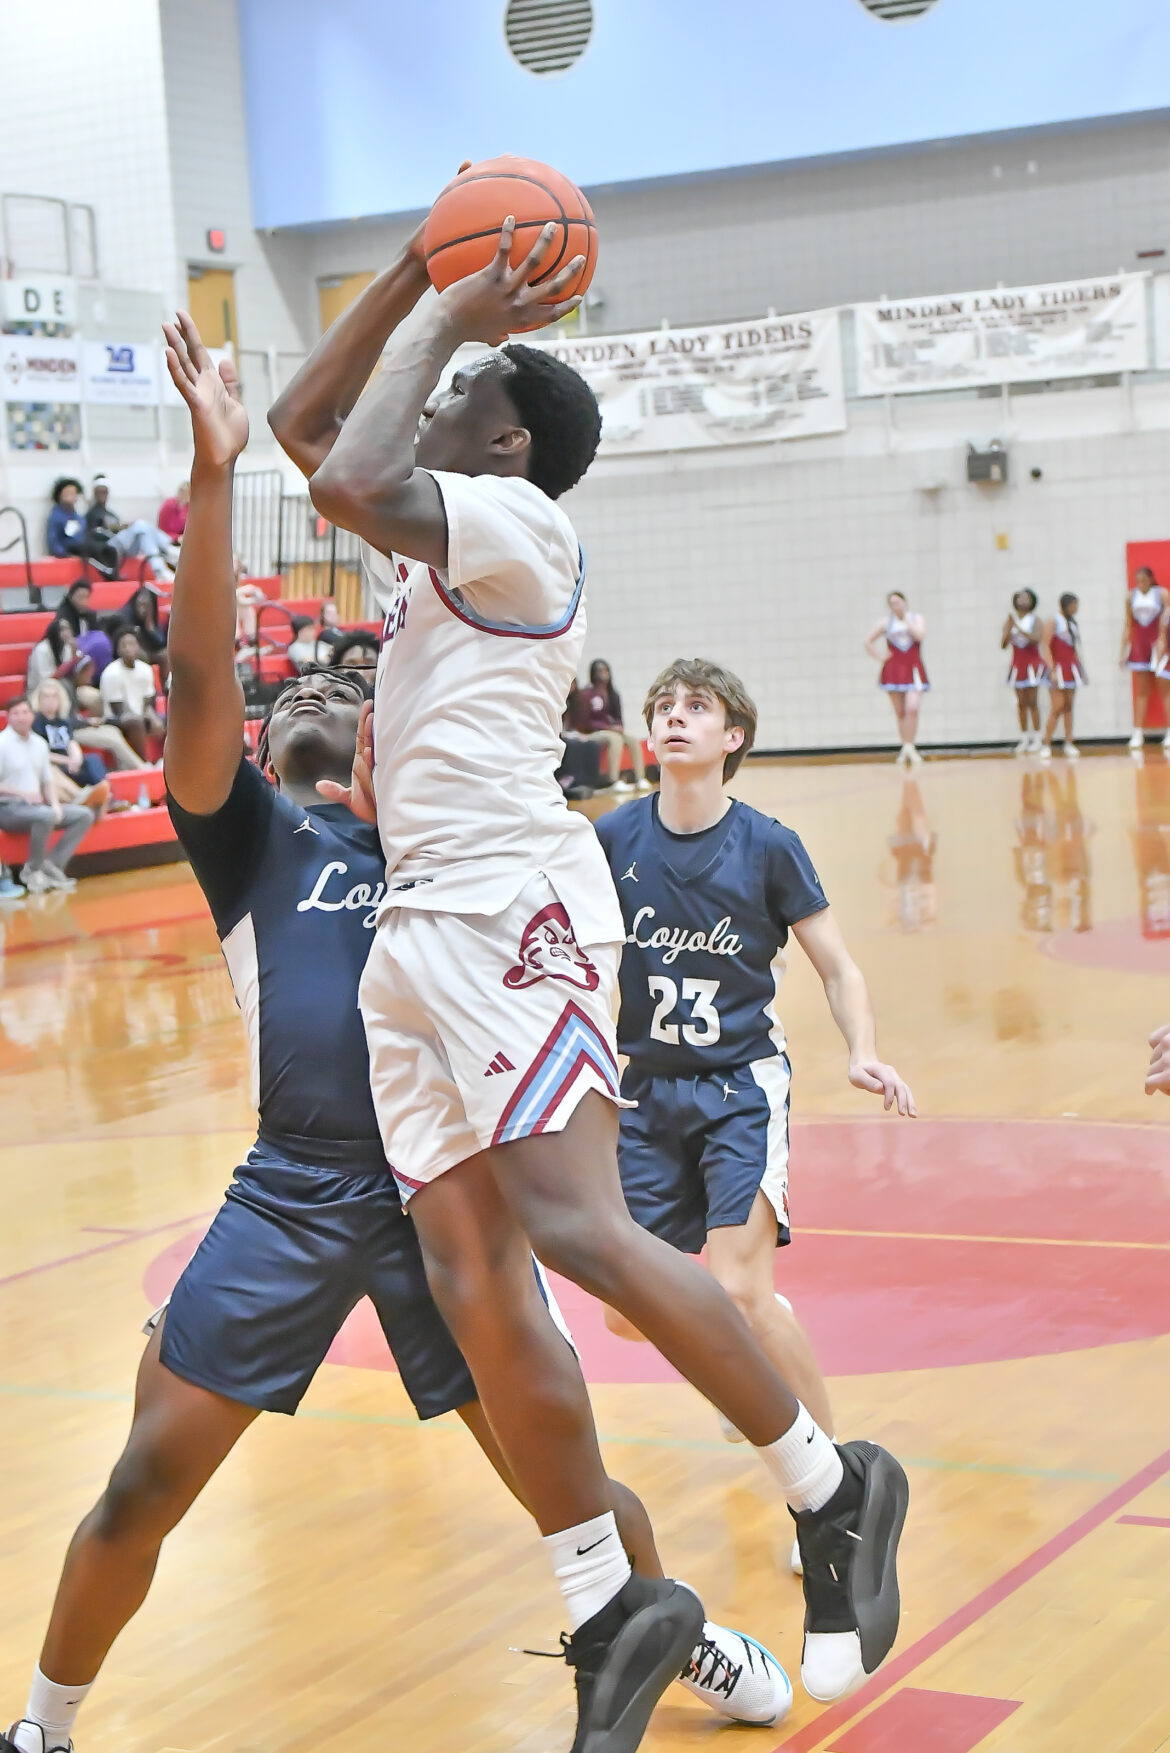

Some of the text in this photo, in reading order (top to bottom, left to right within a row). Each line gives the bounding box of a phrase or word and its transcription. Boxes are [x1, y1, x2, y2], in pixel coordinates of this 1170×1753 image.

[878, 304, 963, 321] MINDEN
[974, 295, 1026, 311] LADY
[1041, 284, 1121, 304] TIDERS
[649, 335, 708, 354] LADY
[723, 321, 813, 349] TIDERS
[626, 906, 743, 965] Loyola
[647, 975, 721, 1047] 23
